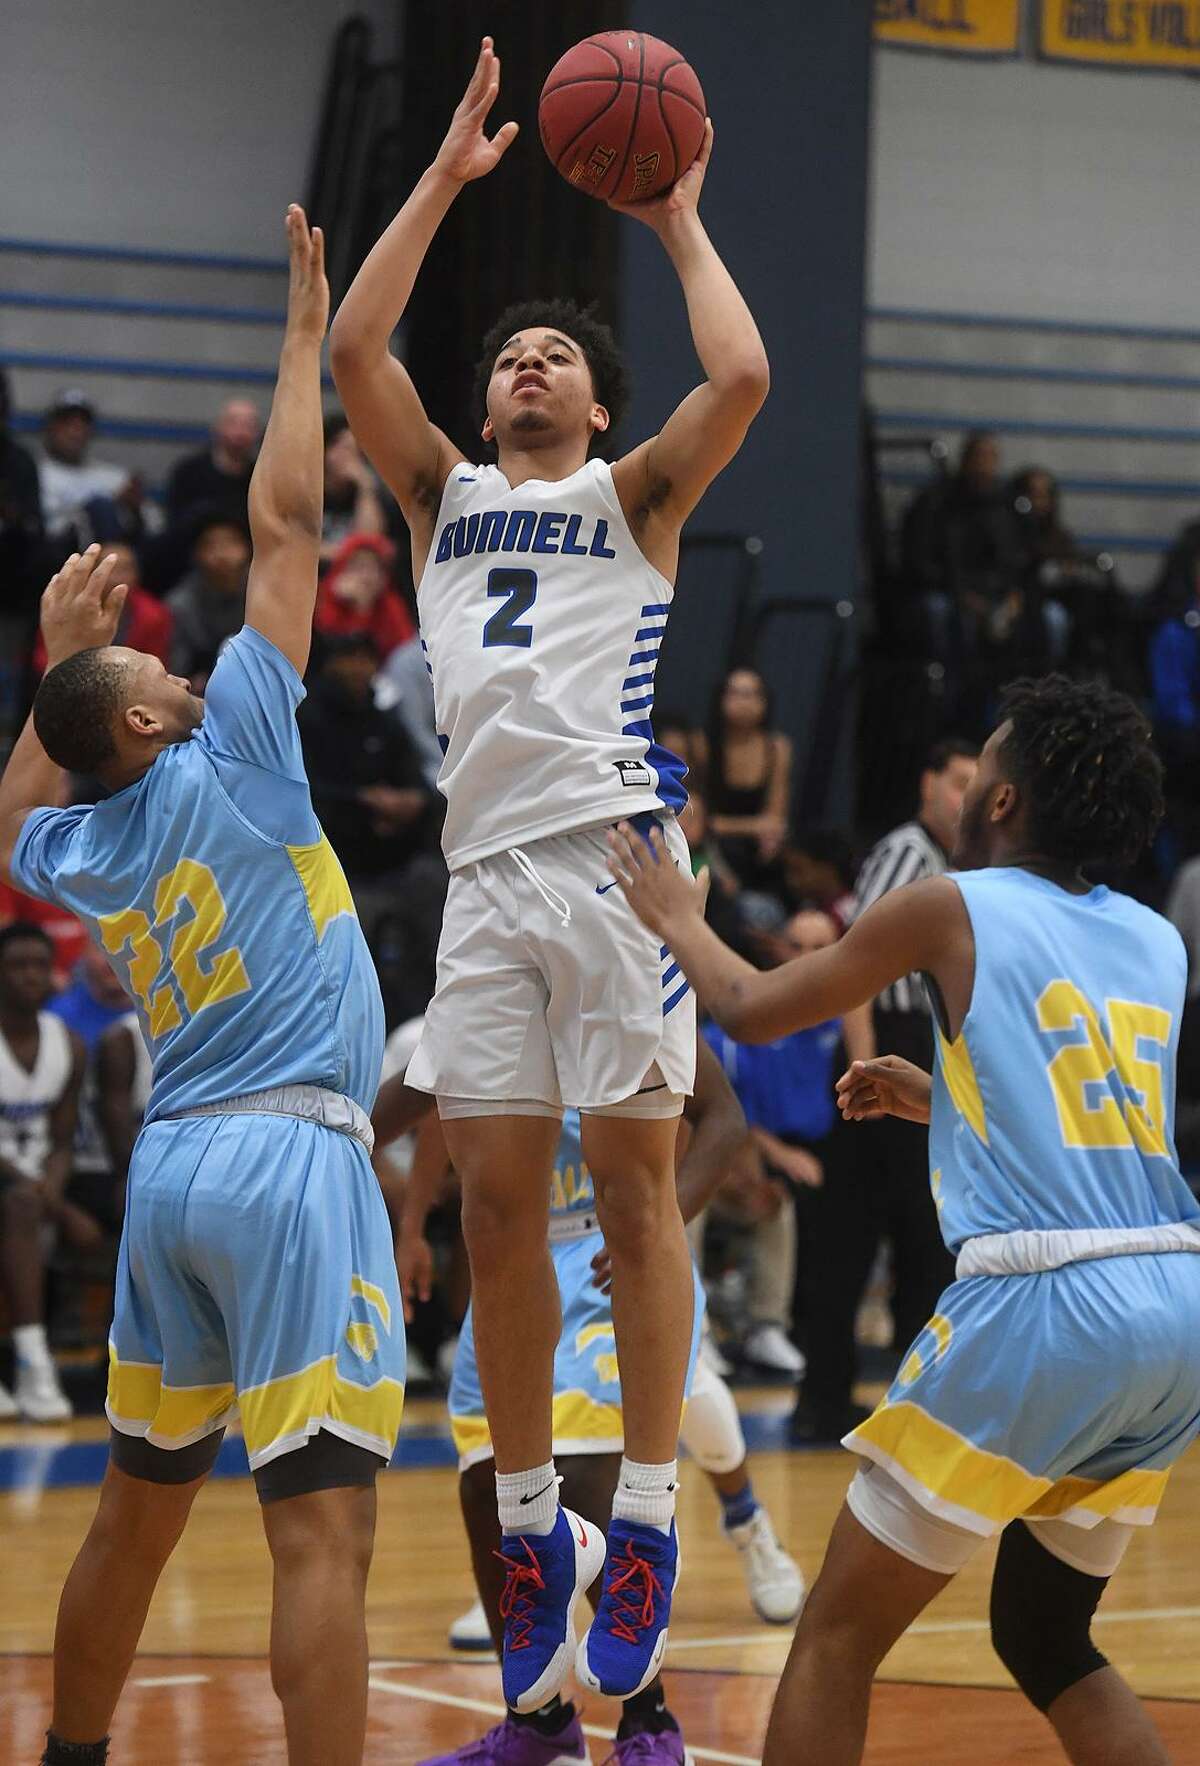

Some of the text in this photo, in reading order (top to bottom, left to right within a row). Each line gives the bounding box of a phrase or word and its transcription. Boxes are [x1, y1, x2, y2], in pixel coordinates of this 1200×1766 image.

[434, 509, 617, 565] BUNNELL
[482, 567, 539, 648] 2
[98, 857, 253, 1041] 22
[1035, 978, 1173, 1158] 25
